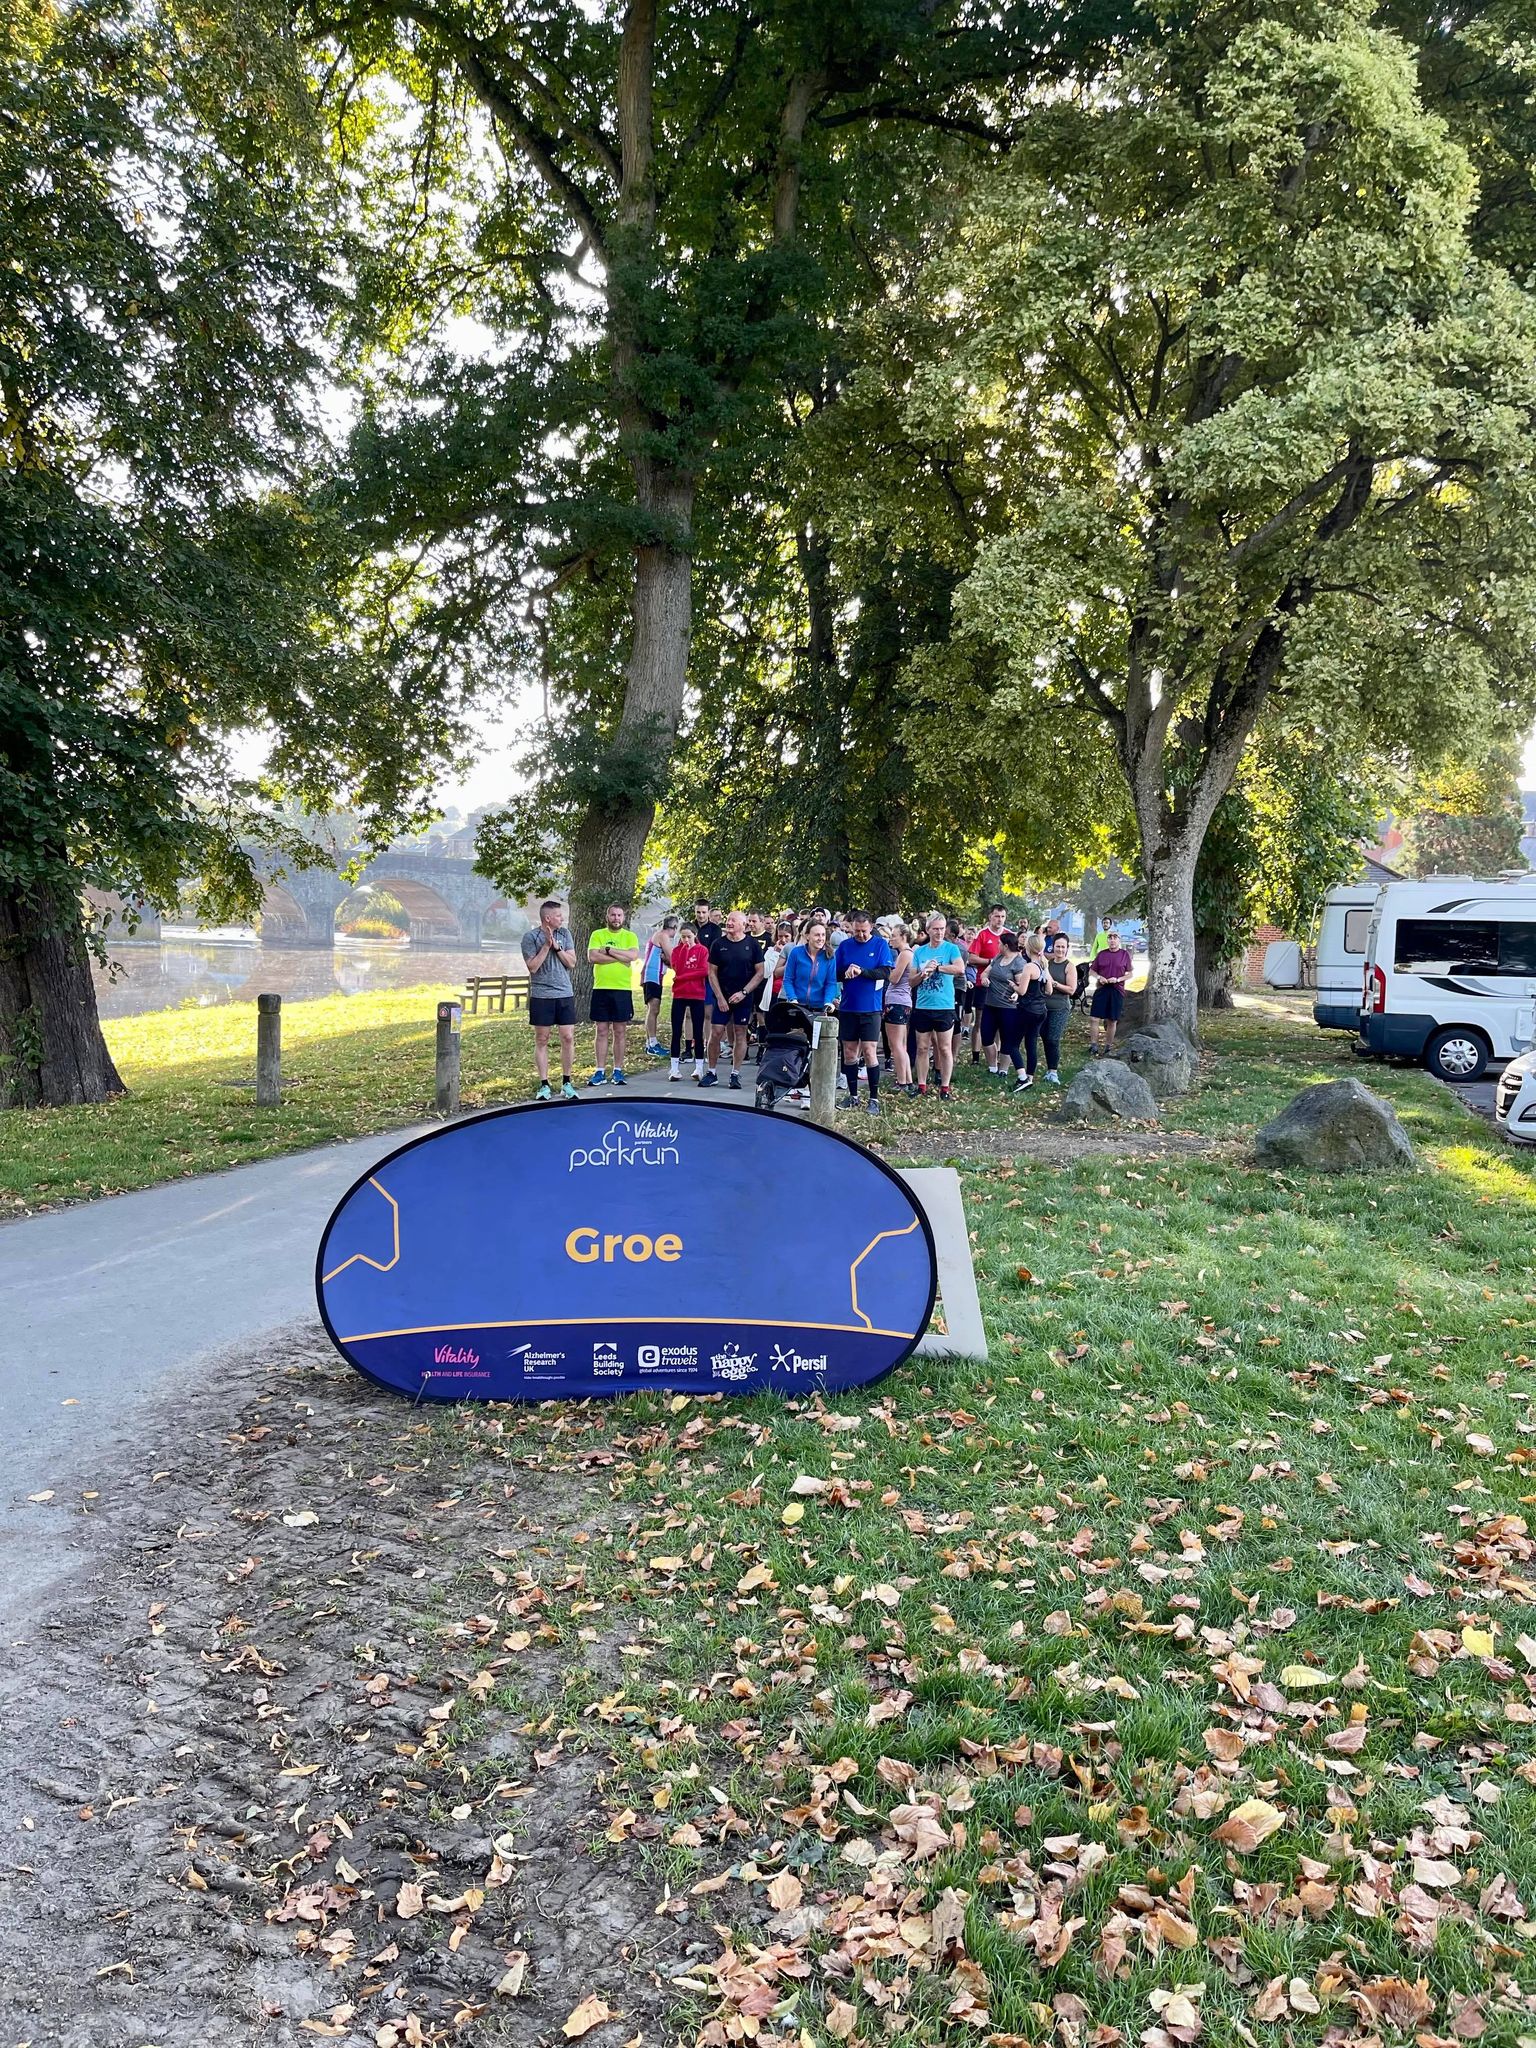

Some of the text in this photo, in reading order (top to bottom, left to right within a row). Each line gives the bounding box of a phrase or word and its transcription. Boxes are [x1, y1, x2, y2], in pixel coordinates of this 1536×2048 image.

[634, 1120, 679, 1144] Vitality
[568, 1136, 680, 1172] parkrun
[565, 1227, 683, 1263] Groe
[434, 1344, 480, 1370] Vitality
[661, 1345, 698, 1356] exodus
[593, 1361, 625, 1370] Building
[661, 1356, 698, 1366] travels
[710, 1353, 758, 1370] happy
[793, 1355, 827, 1374] Persil
[593, 1369, 623, 1377] Society
[721, 1367, 748, 1381] egg
